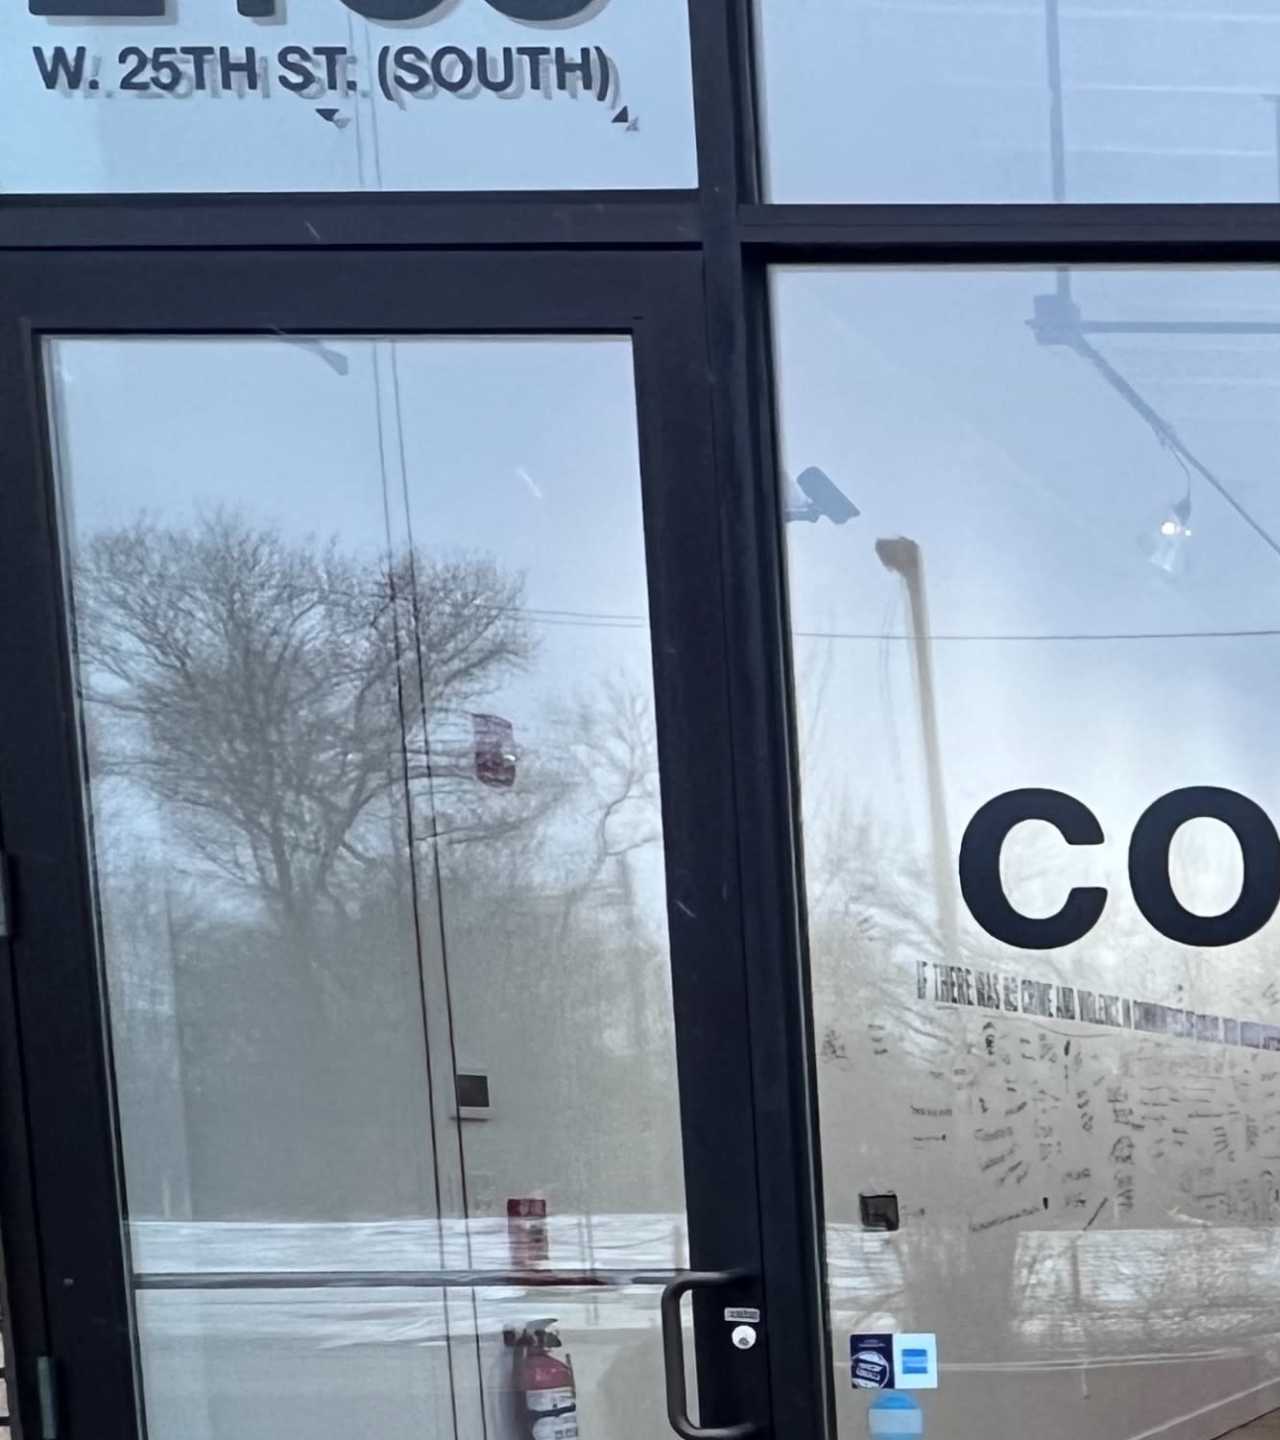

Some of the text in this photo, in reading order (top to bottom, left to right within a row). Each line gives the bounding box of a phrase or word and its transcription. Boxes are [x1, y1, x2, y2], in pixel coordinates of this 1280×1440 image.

[32, 46, 611, 101] W. 25TH ST. (SOUTH)
